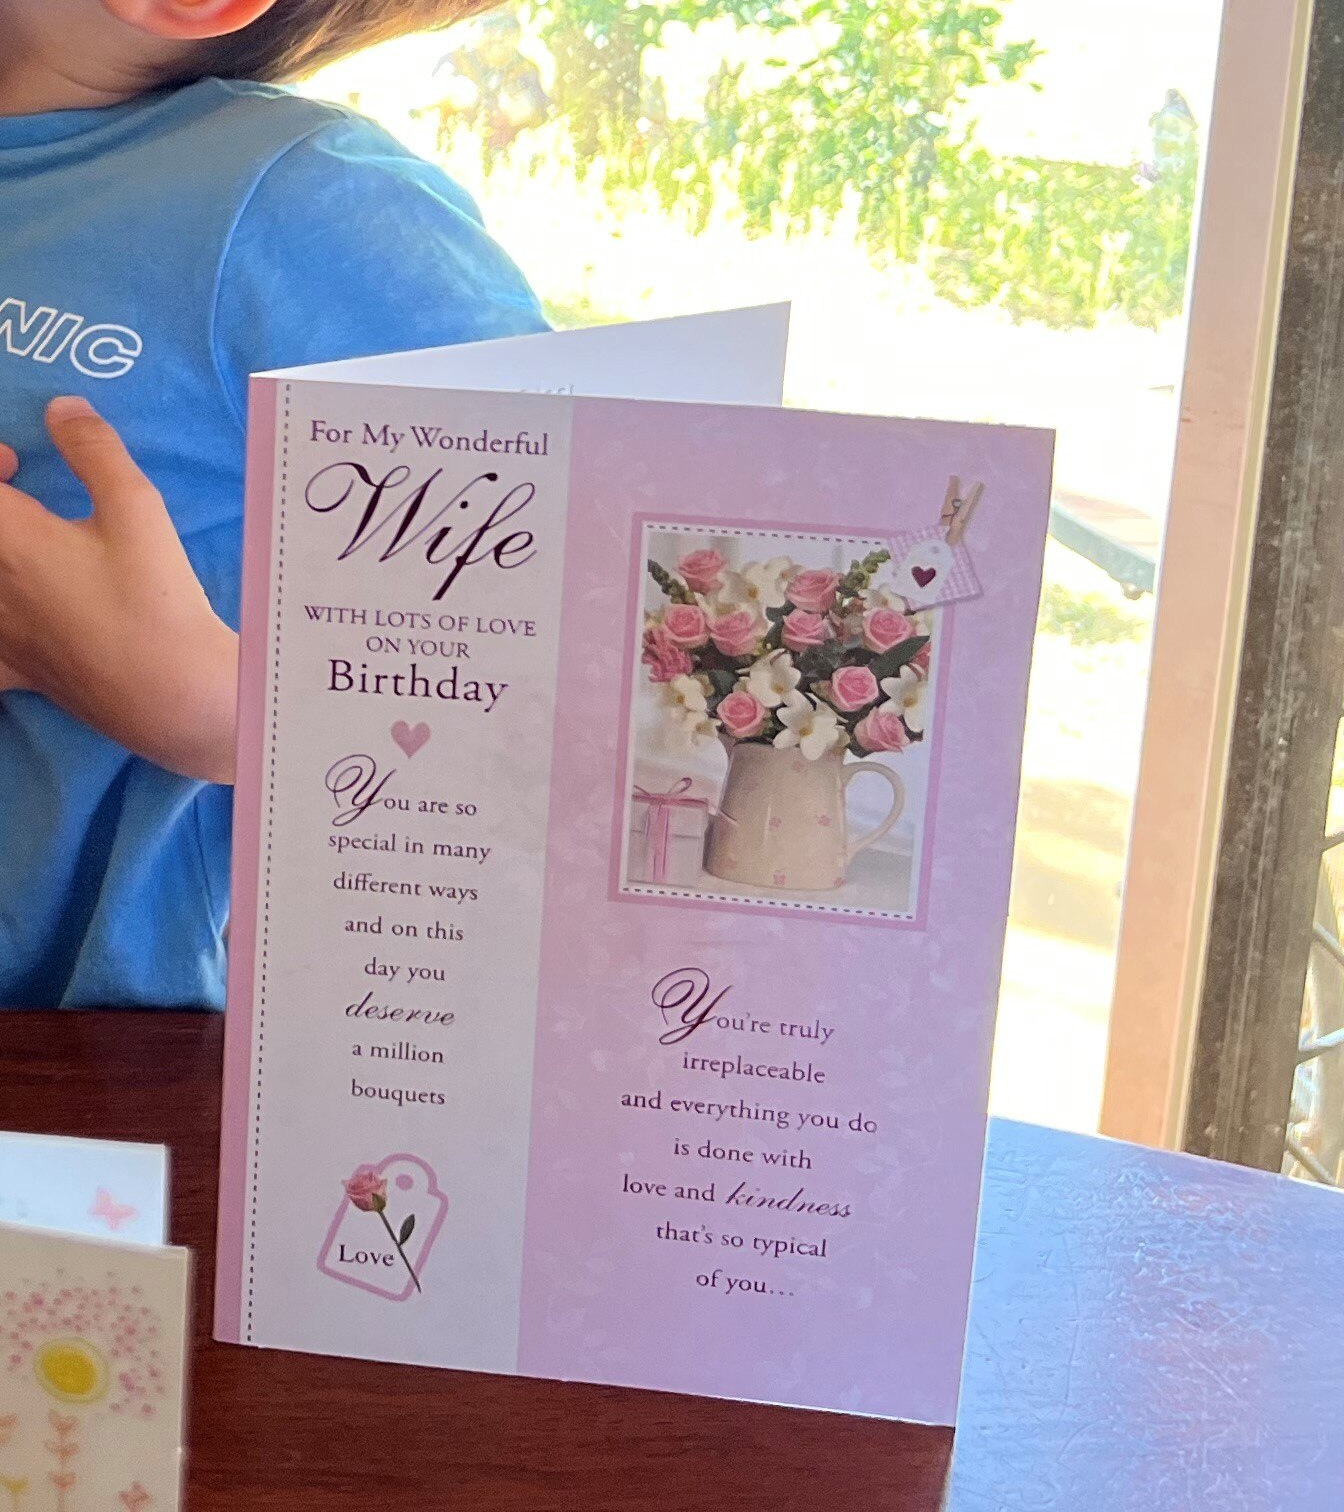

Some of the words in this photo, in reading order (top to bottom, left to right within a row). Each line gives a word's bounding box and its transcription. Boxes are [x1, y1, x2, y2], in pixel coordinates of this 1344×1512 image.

[310, 419, 353, 444] For
[361, 422, 405, 454] My
[409, 425, 548, 456] Wonderful
[304, 461, 536, 601] Wife
[303, 604, 367, 626] WITH
[374, 609, 432, 630] LOTS
[437, 614, 469, 633] OF
[476, 616, 537, 637] LOVE
[365, 636, 400, 654] ON
[407, 638, 471, 659] YOUR
[327, 658, 509, 714] Birthday
[324, 753, 410, 827] You
[417, 800, 449, 815] are
[455, 803, 478, 817] so
[328, 832, 397, 854] special
[404, 835, 424, 855] in
[432, 843, 492, 865] many
[332, 870, 421, 897] different
[428, 885, 479, 905] ways
[344, 915, 383, 935] and
[391, 924, 418, 938] on
[426, 920, 464, 941] this
[363, 956, 401, 982] day
[406, 966, 446, 984] you
[344, 990, 455, 1026] deserve
[651, 967, 771, 1046] You're
[779, 1019, 835, 1046] truly
[351, 1044, 362, 1056] a
[370, 1041, 444, 1064] million
[682, 1051, 826, 1084] irreplaceable
[351, 1077, 446, 1108] bouquets
[620, 1090, 662, 1110] and
[669, 1098, 790, 1130] everything
[798, 1112, 840, 1130] you
[847, 1112, 878, 1133] do
[673, 1137, 690, 1156] is
[697, 1139, 754, 1163] done
[761, 1149, 812, 1170] with
[622, 1173, 667, 1197] love
[674, 1182, 716, 1203] and
[725, 1181, 851, 1218] kindness
[338, 1243, 395, 1267] Love
[656, 1220, 713, 1244] that's
[721, 1234, 744, 1248] so
[753, 1236, 827, 1259] typical
[695, 1268, 721, 1288] of
